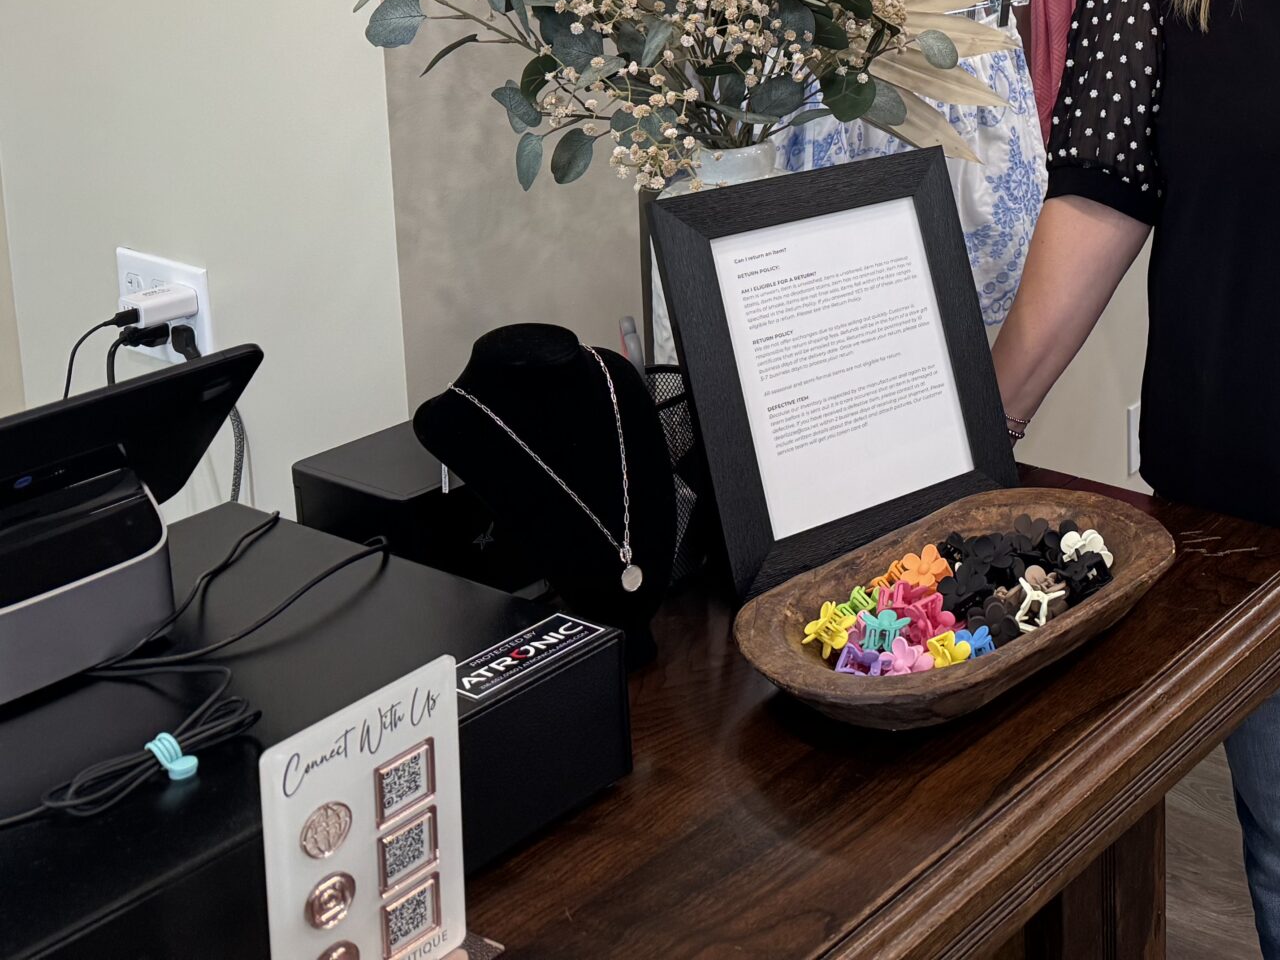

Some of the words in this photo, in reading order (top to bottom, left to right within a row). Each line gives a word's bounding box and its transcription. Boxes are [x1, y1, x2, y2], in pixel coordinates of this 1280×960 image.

[737, 270, 759, 280] RETURN
[759, 265, 780, 274] POLICY:
[753, 282, 777, 292] ELIGIBLE
[794, 271, 817, 281] RETURN?
[752, 335, 774, 345] RETURN
[774, 330, 794, 339] POLICY
[767, 400, 796, 412] DEFECTIVE
[796, 395, 809, 403] ITEM
[462, 621, 583, 690] ATRONIC
[469, 638, 524, 667] PROTECTED
[523, 630, 536, 641] BY
[283, 726, 356, 797] Connect
[359, 701, 405, 754] With
[410, 687, 440, 727] Us
[408, 929, 448, 960] TIQUE
